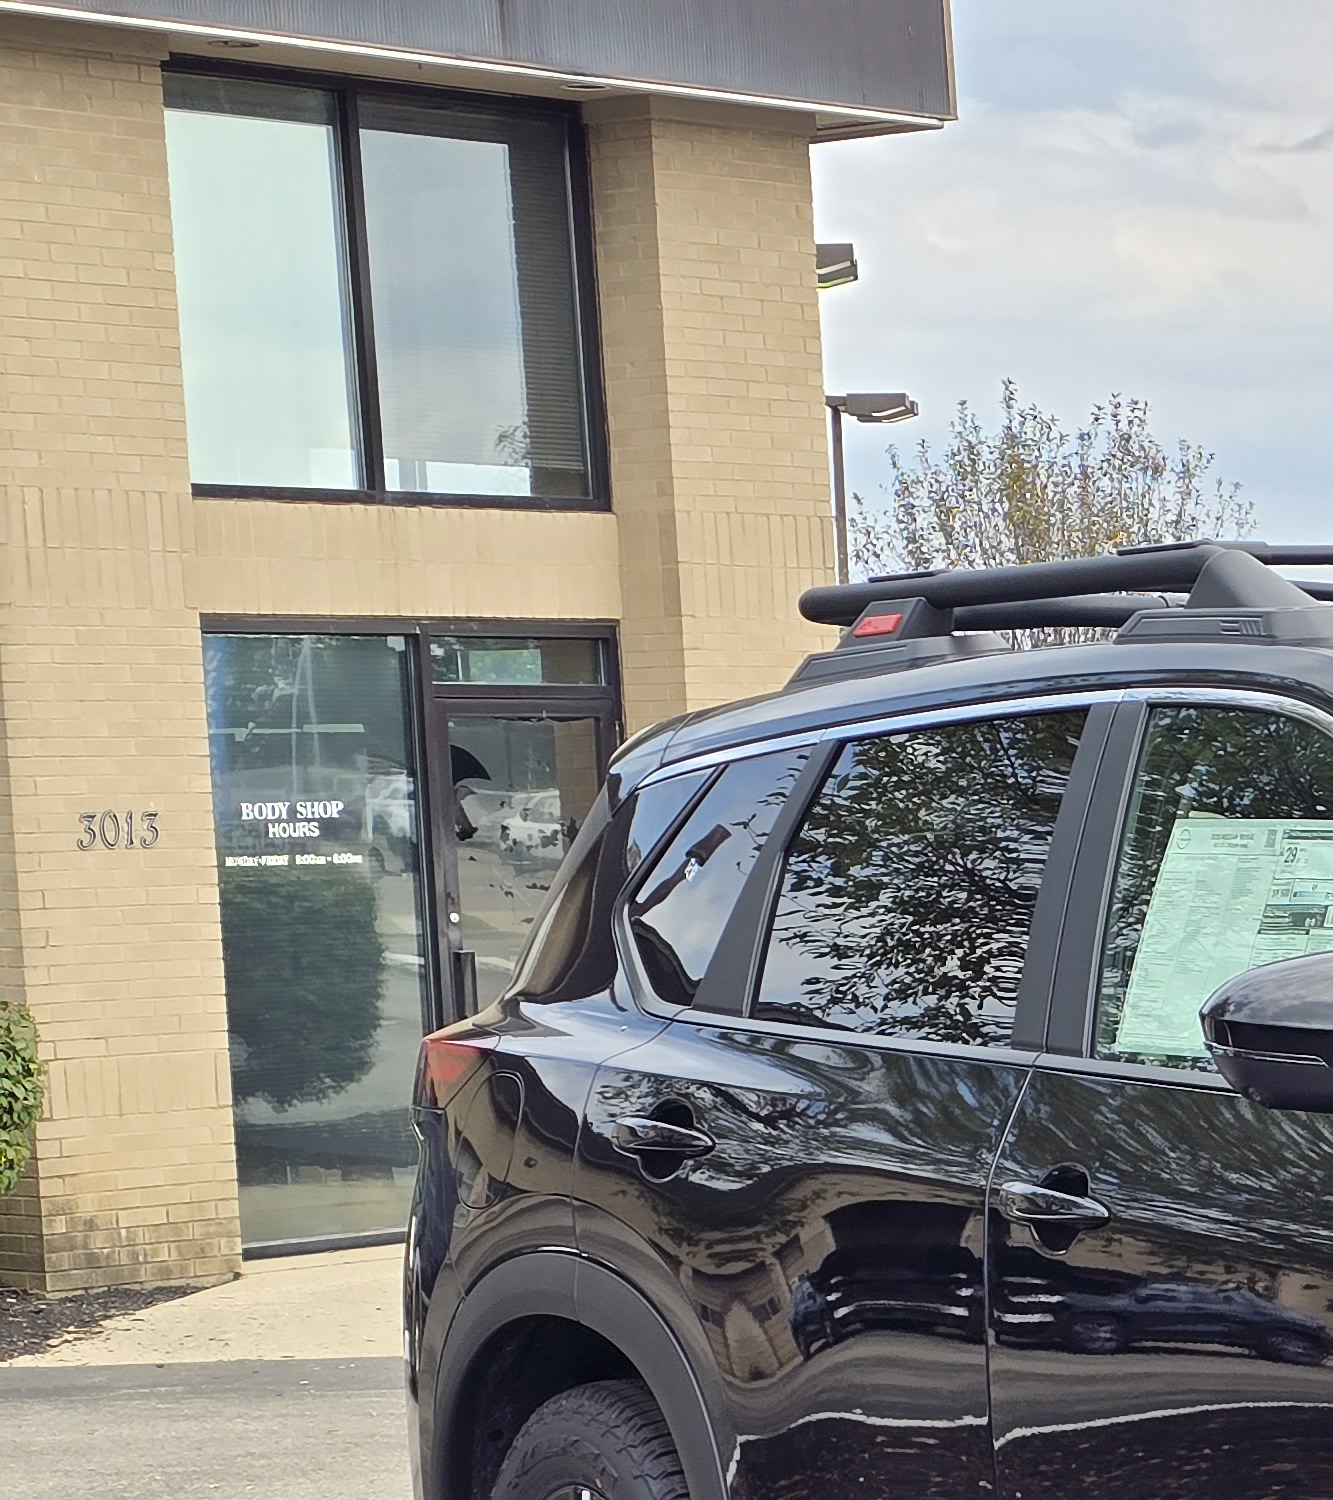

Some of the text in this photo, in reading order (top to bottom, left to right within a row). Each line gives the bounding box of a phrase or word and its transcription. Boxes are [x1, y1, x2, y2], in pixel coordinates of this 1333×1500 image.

[240, 800, 344, 820] BODY SHOP
[77, 810, 159, 850] 3013
[267, 821, 320, 838] HOURS
[1283, 846, 1298, 864] 29
